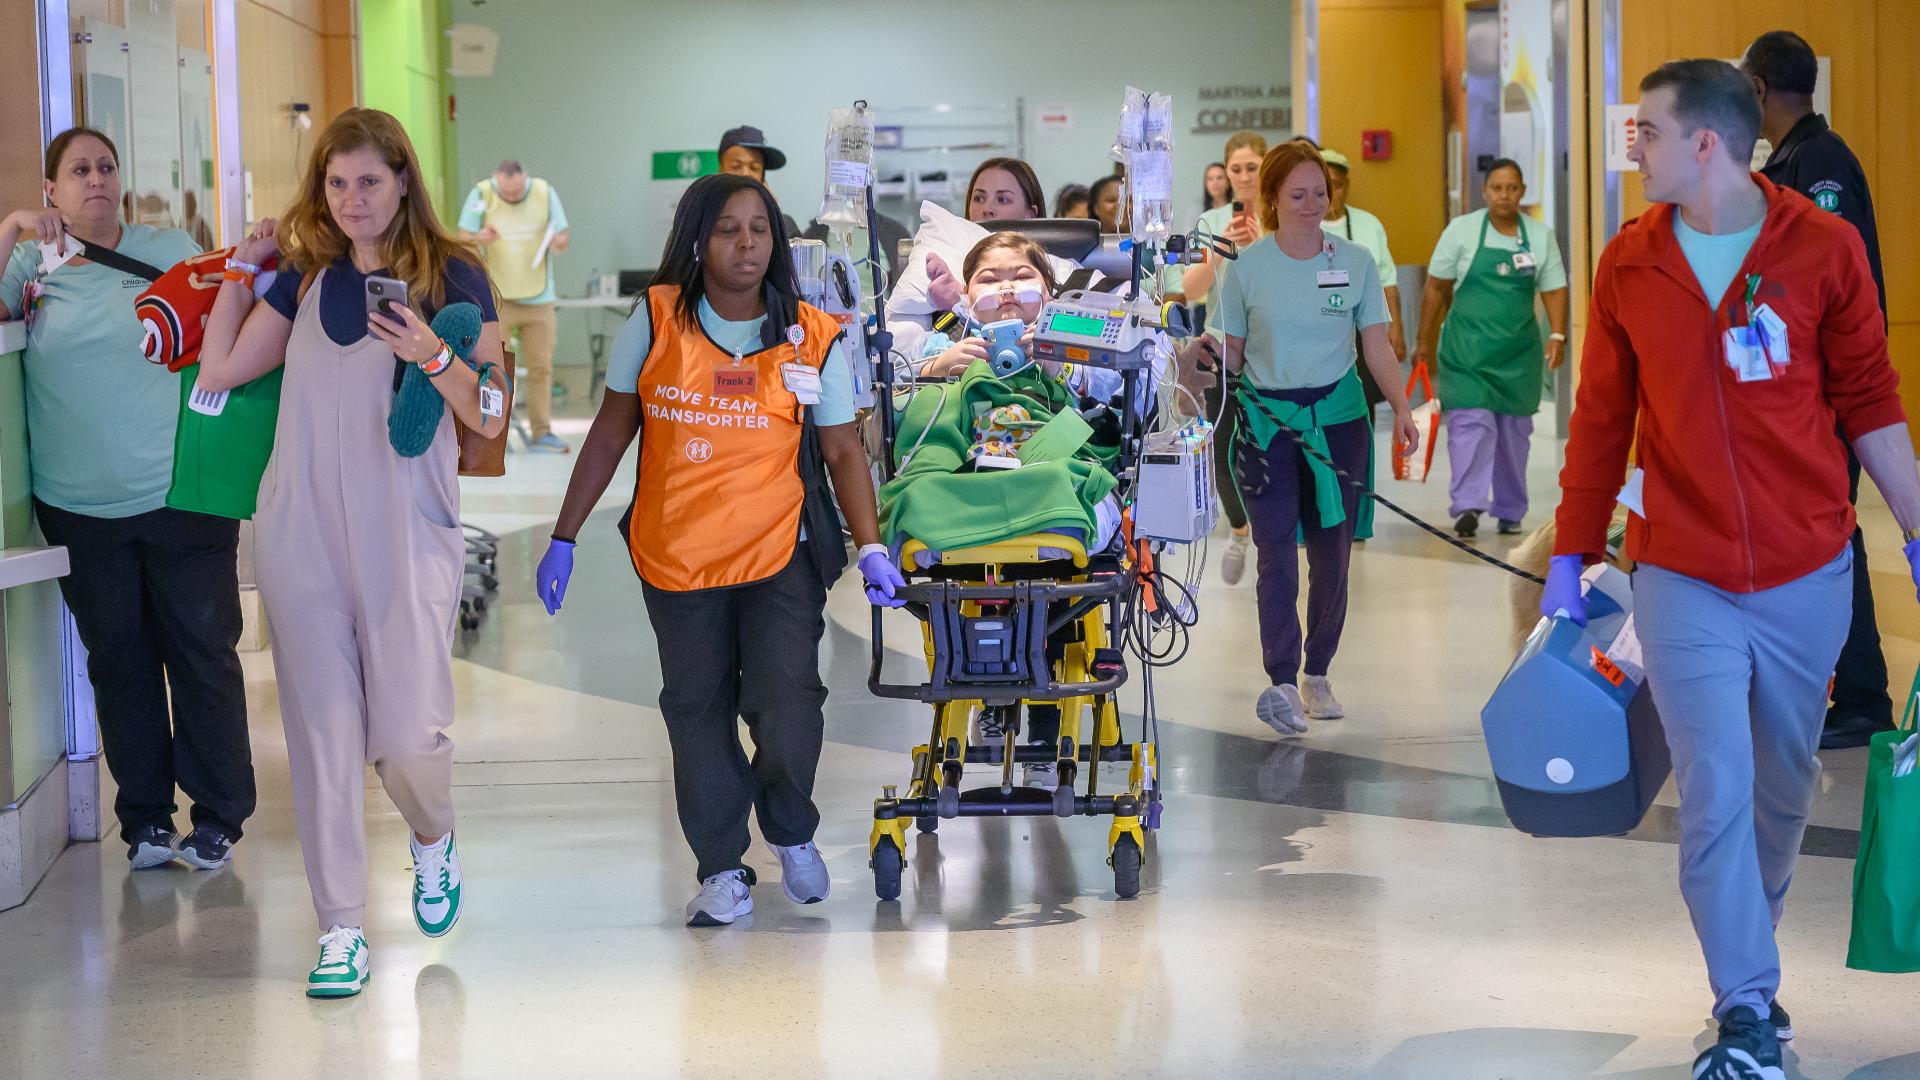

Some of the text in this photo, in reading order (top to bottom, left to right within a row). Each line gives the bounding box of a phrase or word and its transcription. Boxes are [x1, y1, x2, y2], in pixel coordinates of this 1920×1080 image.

[1199, 86, 1264, 100] MARTHA
[717, 376, 753, 386] Track 2
[655, 384, 758, 413] MOVE TEAM
[646, 402, 769, 429] TRANSPORTER
